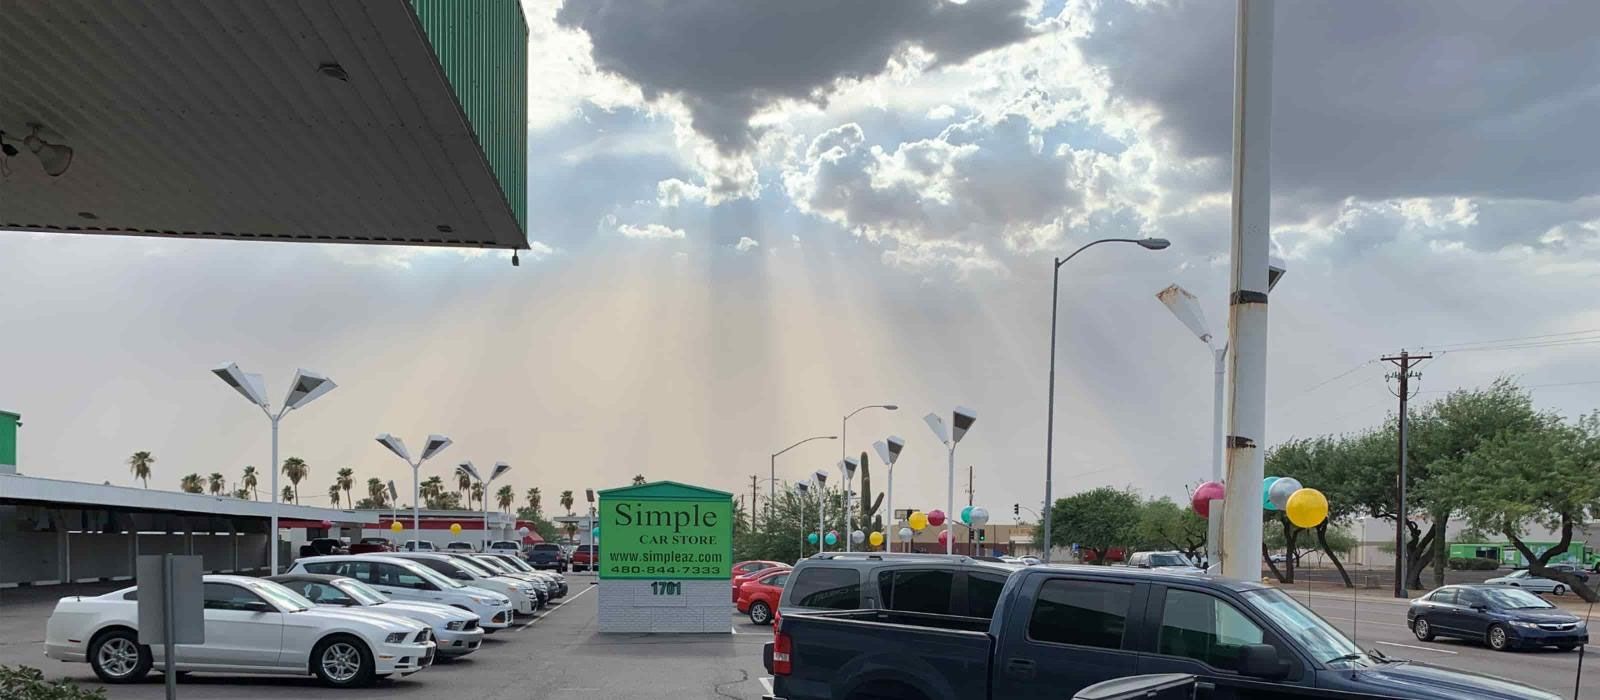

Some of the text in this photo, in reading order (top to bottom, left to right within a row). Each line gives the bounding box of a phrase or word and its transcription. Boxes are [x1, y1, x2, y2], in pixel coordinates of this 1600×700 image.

[615, 503, 717, 533] Simple
[639, 535, 717, 545] CAR STORE
[609, 550, 722, 564] www.simpleaz.com
[611, 566, 720, 574] 480-844-7333
[650, 581, 682, 595] 1701
